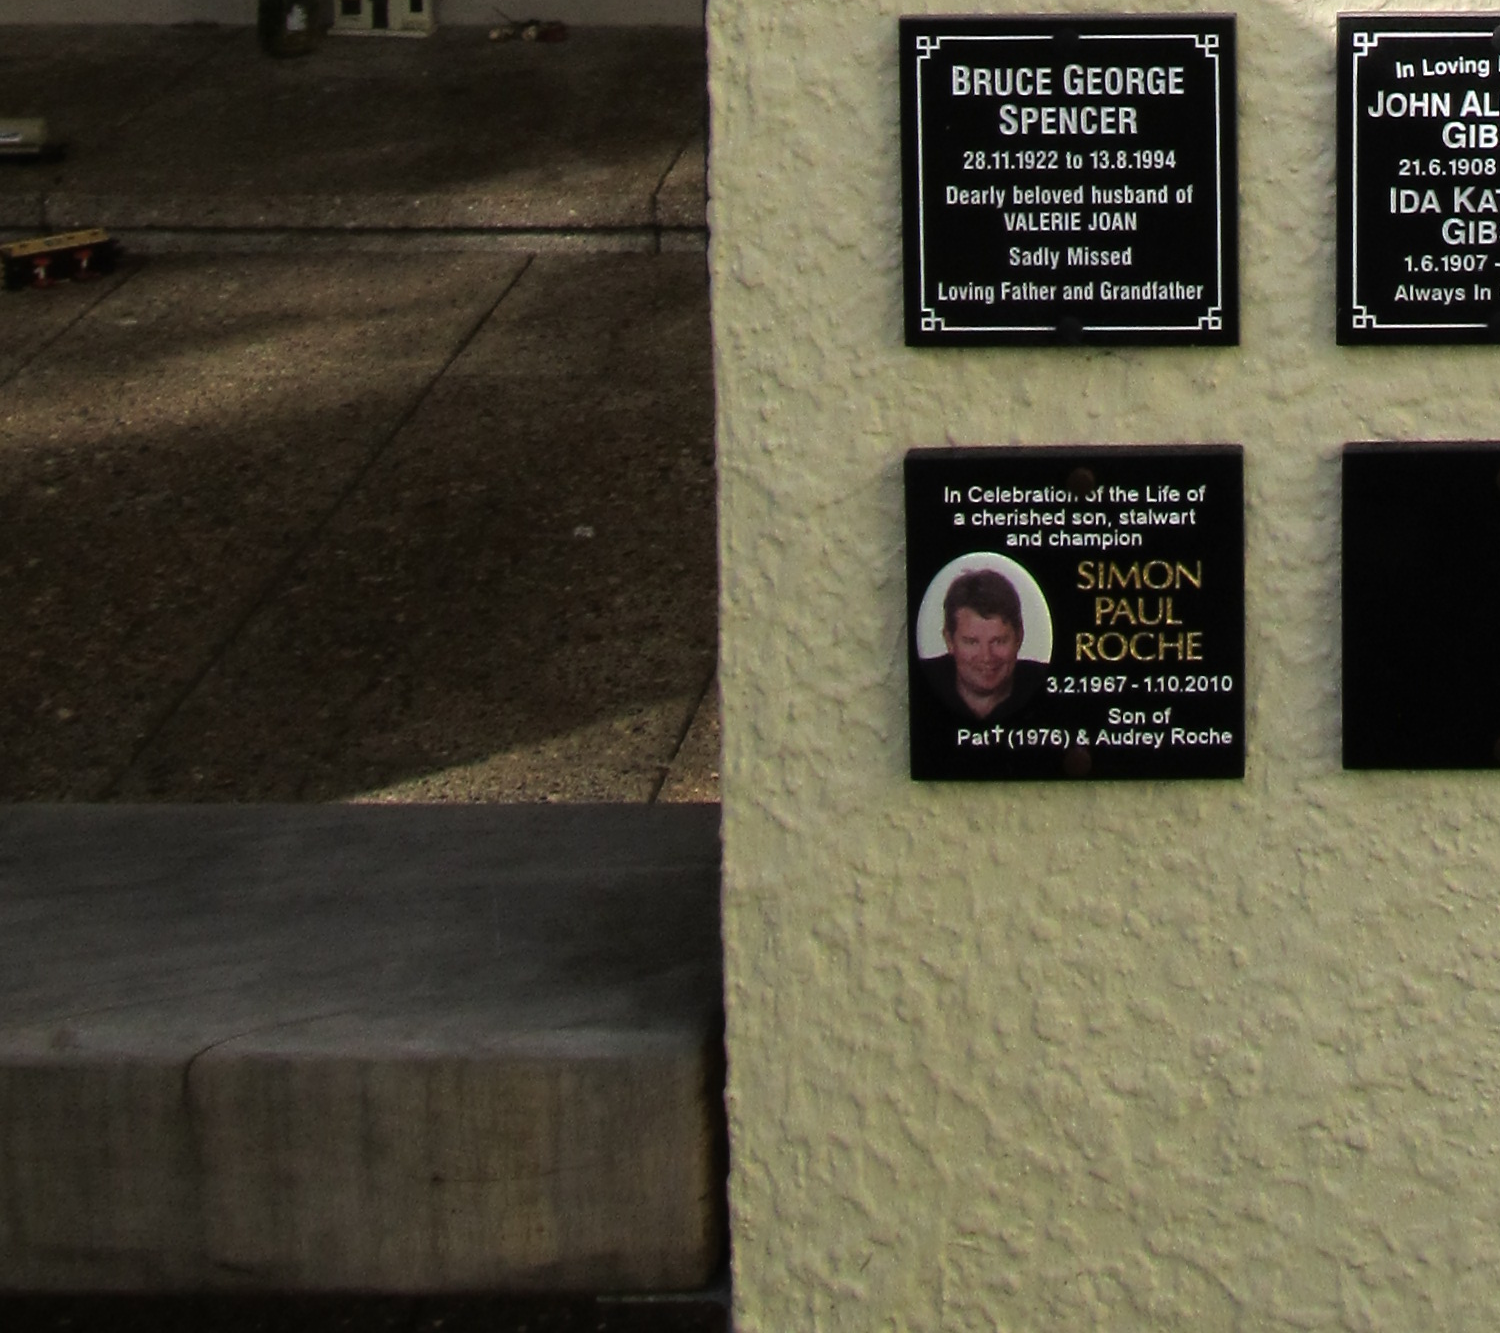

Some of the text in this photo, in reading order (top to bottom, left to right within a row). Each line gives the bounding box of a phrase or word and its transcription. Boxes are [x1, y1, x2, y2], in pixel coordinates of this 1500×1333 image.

[952, 64, 1184, 96] BRUCE GEORGE
[1368, 91, 1450, 117] JOHN
[999, 104, 1137, 135] SPENCER
[963, 150, 1176, 170] 28.11.1922 to 13.8.1994
[1399, 158, 1496, 176] 21.6.1908
[1390, 187, 1441, 214] IDA
[1004, 212, 1137, 231] VALERIE JOAN
[1009, 246, 1132, 270] Sadly Missed
[1404, 254, 1488, 272] 1.6.1907
[938, 281, 1204, 304] Loving Father and Grandfather
[954, 509, 1196, 527] a cherished son, stalwart
[1077, 560, 1201, 590] SIMON
[1095, 597, 1183, 625] PAUL
[1076, 632, 1203, 661] ROCHE
[1047, 676, 1127, 693] 3.2.1967
[1144, 675, 1233, 692] 1.10.2010
[1108, 707, 1171, 725] Son of
